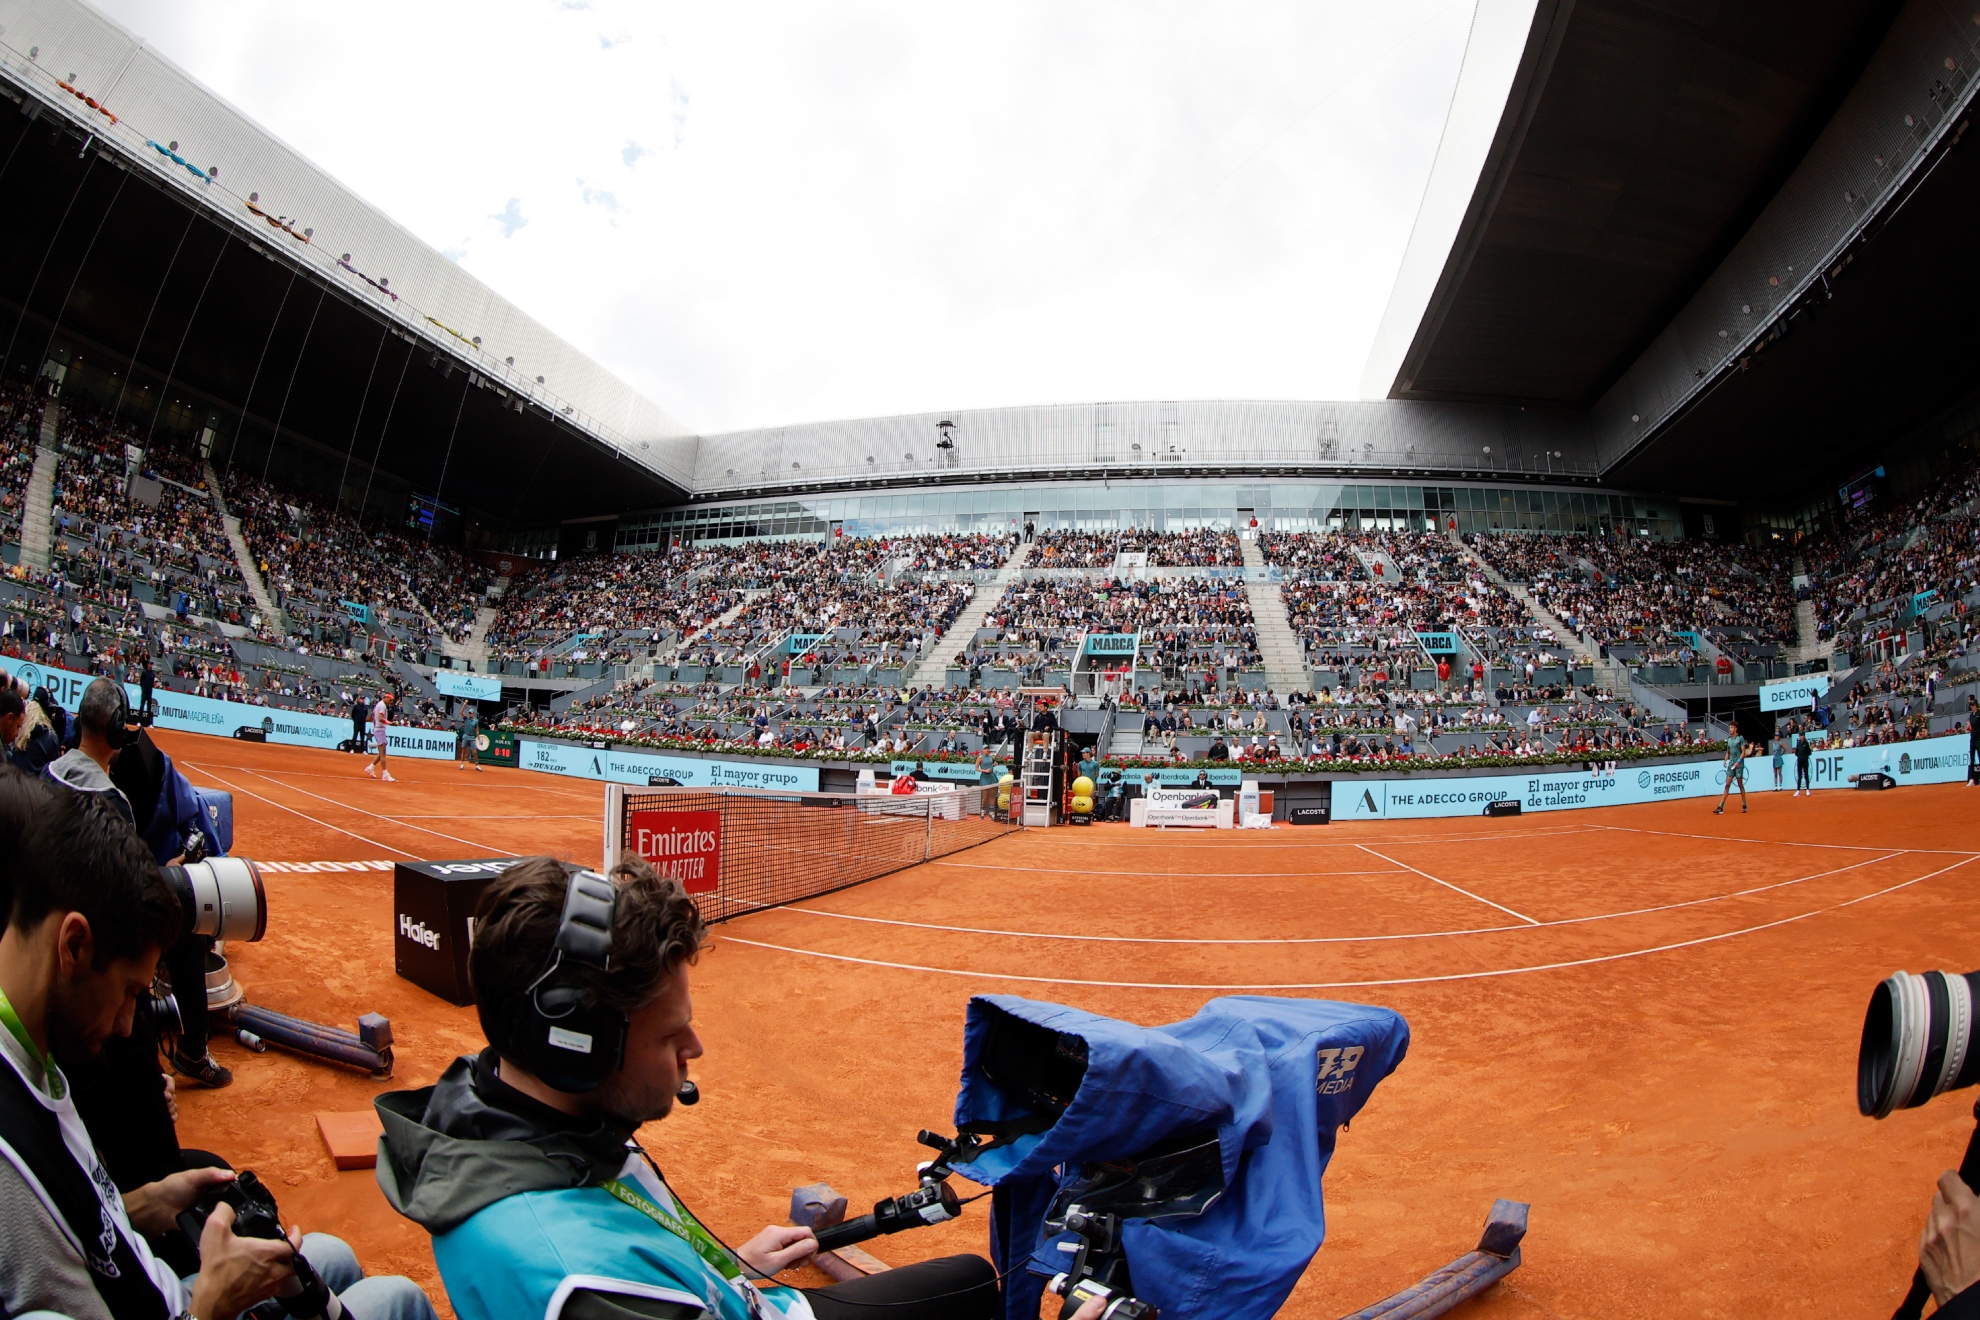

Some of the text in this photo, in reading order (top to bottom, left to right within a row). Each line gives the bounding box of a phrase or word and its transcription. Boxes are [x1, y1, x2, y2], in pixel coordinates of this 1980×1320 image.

[1092, 637, 1134, 651] MARCA
[47, 674, 82, 705] PIF
[452, 685, 484, 694] ANANTARA
[1771, 688, 1814, 702] DEKTON
[162, 706, 224, 725] MUTUAMADRILEÑA
[245, 727, 264, 735] LACOSTE
[276, 723, 333, 739] MUTUAMADRILEÑA
[426, 739, 454, 752] DAMM
[537, 750, 549, 761] 182
[533, 762, 566, 772] DUNLOP
[610, 762, 693, 780] THE ADECCO GROUP
[949, 767, 976, 775] Iberdrola
[1816, 756, 1844, 782] PIF
[711, 765, 798, 787] El mayor grupo
[1161, 773, 1189, 781] Iberdrola
[1209, 773, 1237, 781] Iberdrola
[1653, 770, 1700, 784] PROSEGUR
[1528, 778, 1615, 794] El mayor grupo
[1653, 784, 1685, 794] SECURITY
[1391, 791, 1507, 805] THE ADECCO GROUP
[1528, 792, 1586, 806] de talento
[637, 826, 716, 858] Emirates
[430, 859, 519, 875] aier
[671, 857, 705, 880] BETTER
[400, 913, 441, 950] Haier
[620, 1186, 708, 1253] FOTÓGRAFOS TV
